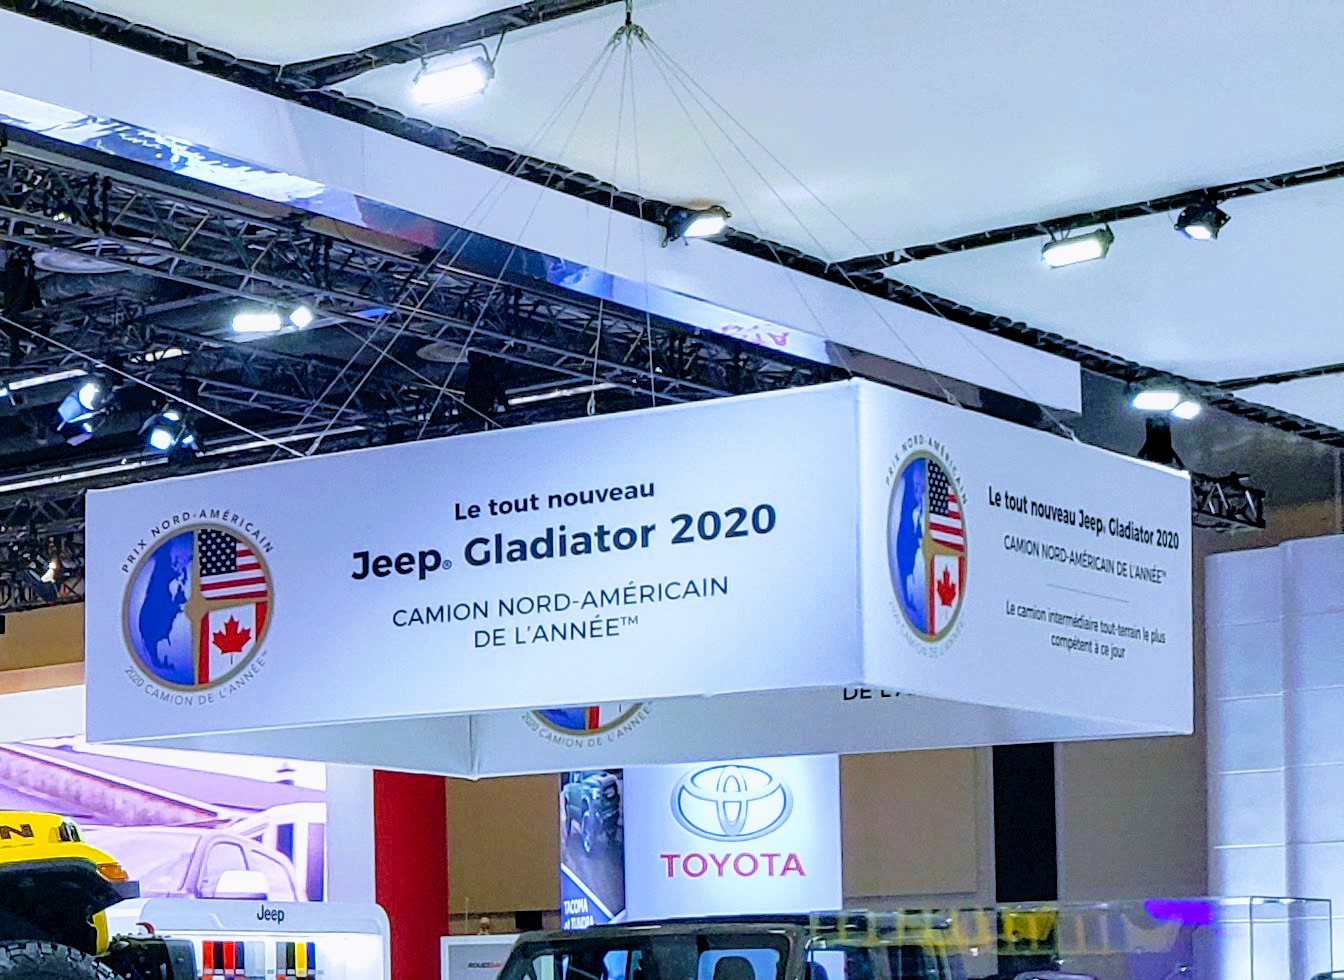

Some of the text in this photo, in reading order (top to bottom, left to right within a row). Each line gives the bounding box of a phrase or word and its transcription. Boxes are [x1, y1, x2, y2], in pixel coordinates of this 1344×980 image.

[455, 482, 655, 520] Le tout nouveau
[988, 485, 1001, 507] Le
[1004, 490, 1028, 514] tout
[1031, 499, 1076, 526] nouveau
[1109, 517, 1154, 546] Gladiator
[1156, 529, 1179, 550] 2020
[121, 508, 274, 574] PRIX NORD-AMÉRICAIN
[464, 523, 656, 566] Gladiator
[670, 503, 777, 545] 2020
[1004, 534, 1040, 558] CAMION
[1041, 543, 1115, 576] NORD-AMÉRICAIN
[1116, 561, 1128, 577] DE
[392, 576, 728, 627] CAMION NORD-AMÉRICAIN
[474, 628, 506, 648] DE
[1005, 600, 1015, 615] Le
[1017, 605, 1047, 620] camion
[1048, 607, 1099, 632] intermédiaire
[1142, 626, 1149, 643] le
[1151, 628, 1166, 645] plus
[1051, 633, 1093, 654] compétent
[1100, 645, 1110, 657] ce
[1110, 643, 1125, 660] jour
[124, 666, 145, 688] 2020
[144, 685, 193, 706] CAMION
[198, 695, 215, 706] DE
[588, 738, 603, 748] DE
[660, 852, 806, 878] TOYOTA
[257, 904, 285, 925] Jeep
